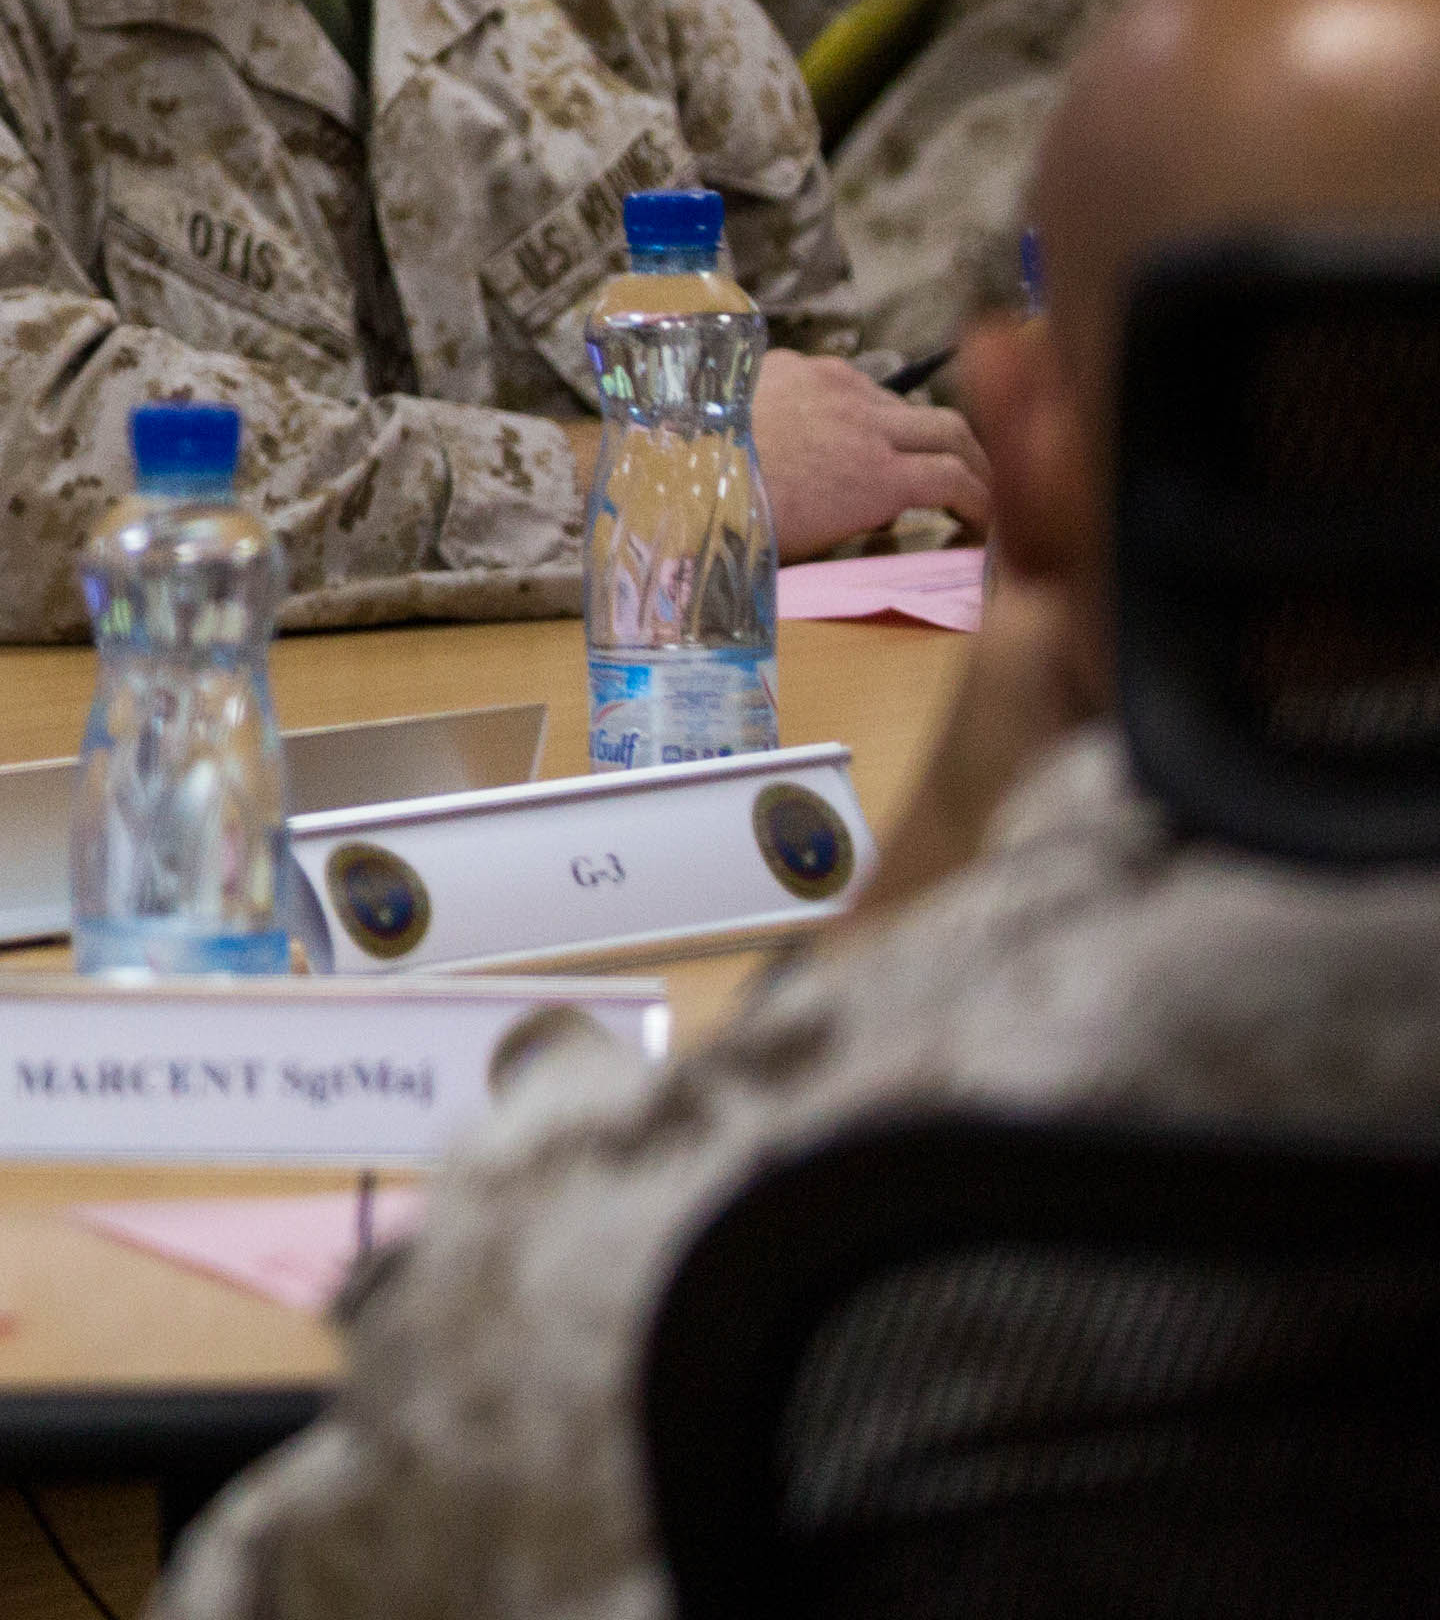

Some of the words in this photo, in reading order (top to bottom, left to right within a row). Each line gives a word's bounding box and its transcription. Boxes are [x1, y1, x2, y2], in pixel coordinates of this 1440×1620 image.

[190, 210, 280, 293] OTIS
[569, 851, 627, 888] G-3
[16, 1058, 264, 1099] MARCENT
[282, 1058, 435, 1110] SgtMaj
